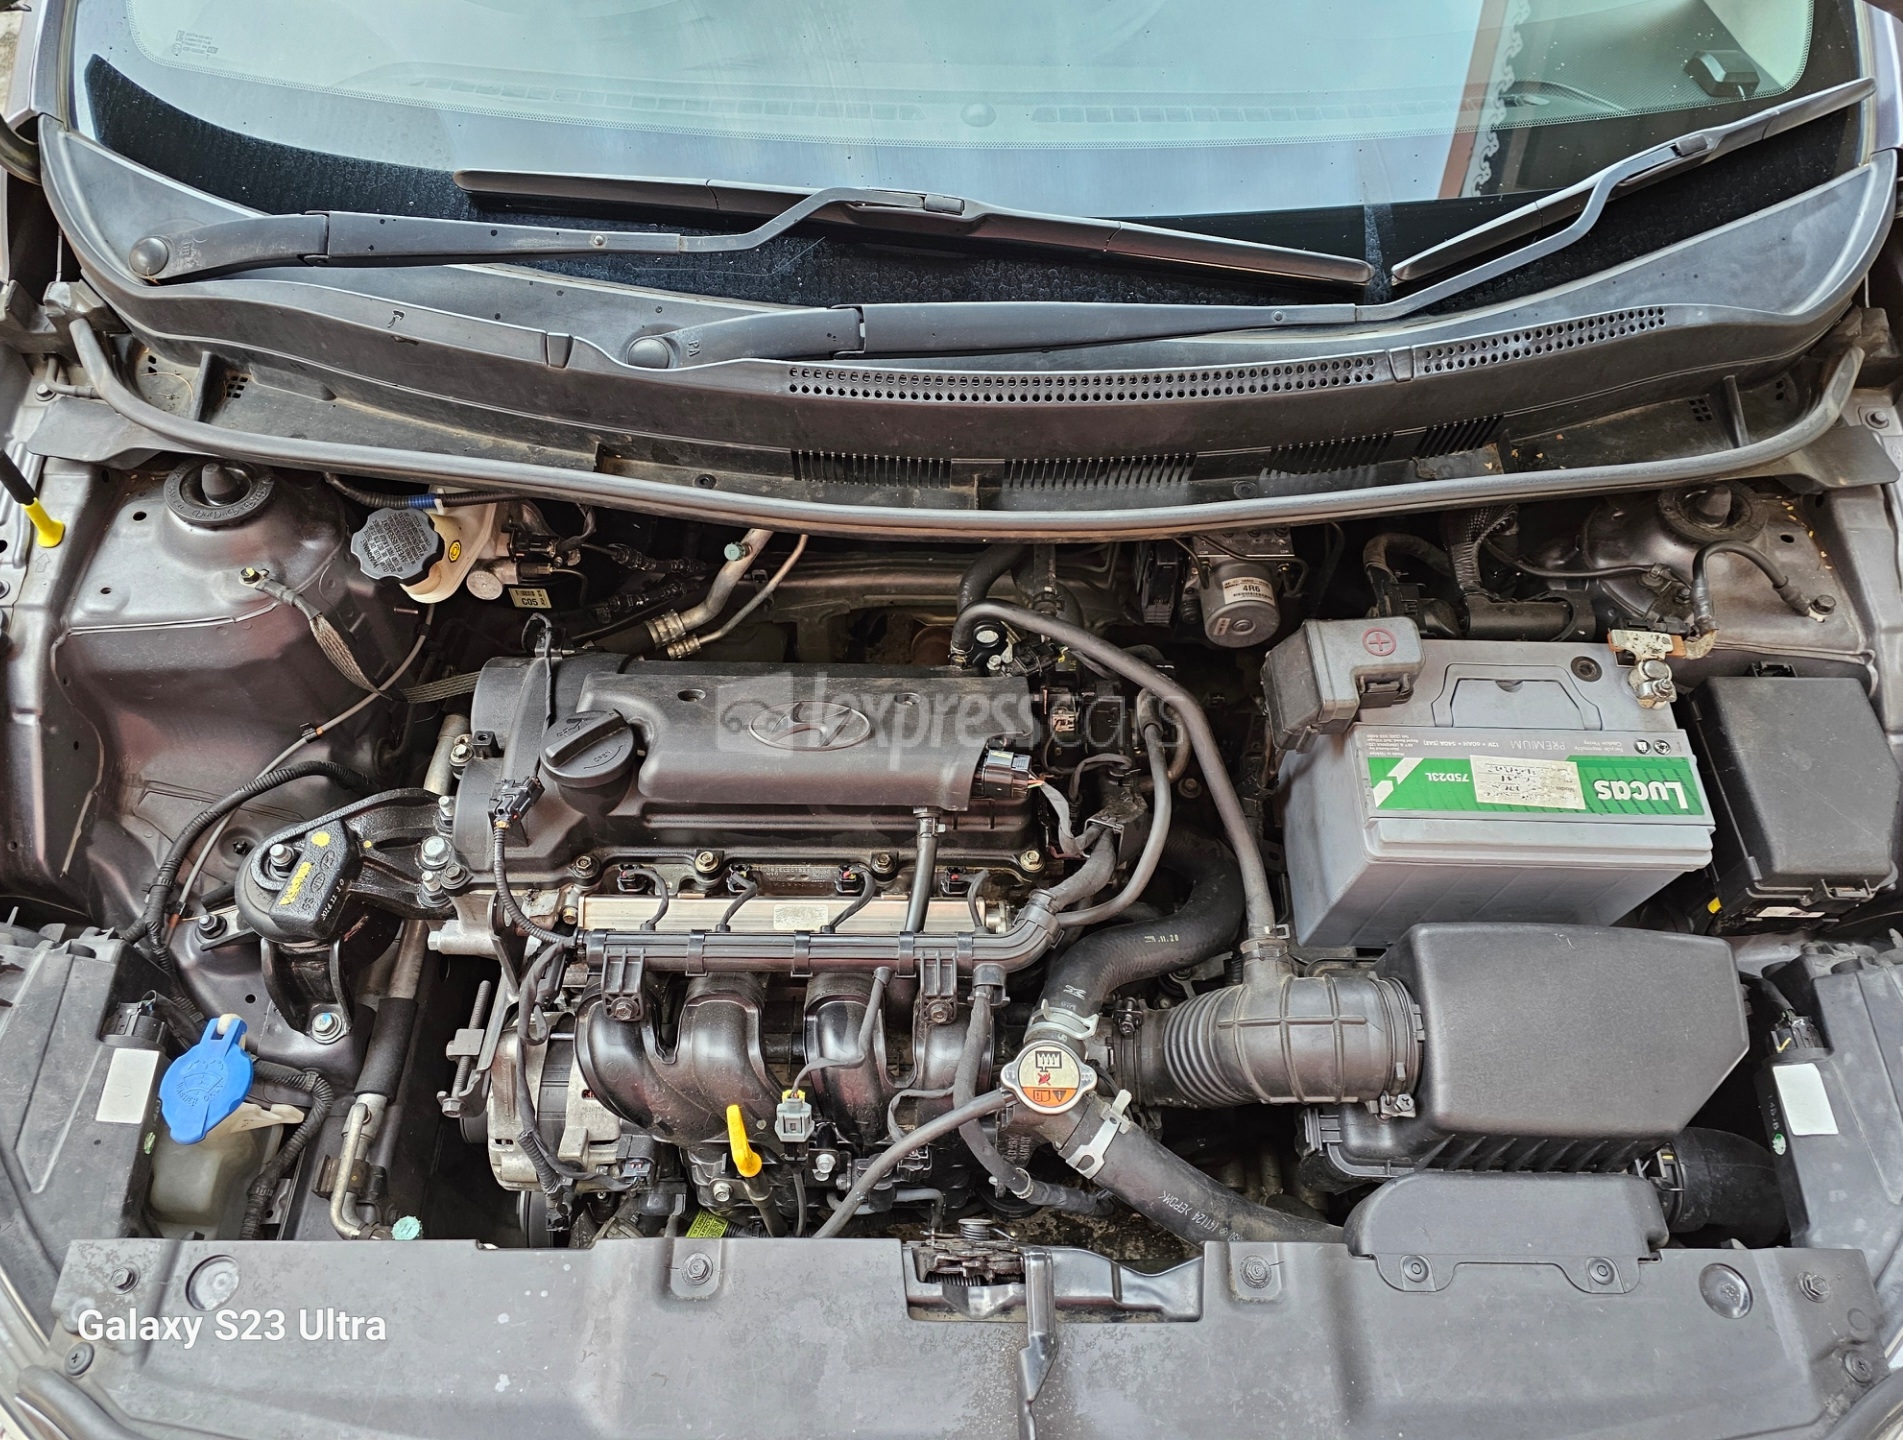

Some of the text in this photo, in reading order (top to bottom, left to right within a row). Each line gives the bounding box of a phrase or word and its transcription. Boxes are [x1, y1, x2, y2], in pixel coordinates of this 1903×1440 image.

[688, 339, 701, 357] PA
[521, 597, 539, 606] C05
[1510, 740, 1566, 751] PREMIUM
[1425, 772, 1470, 782] 75D23L
[1593, 779, 1690, 810] Lucas
[176, 1081, 199, 1107] WASHER
